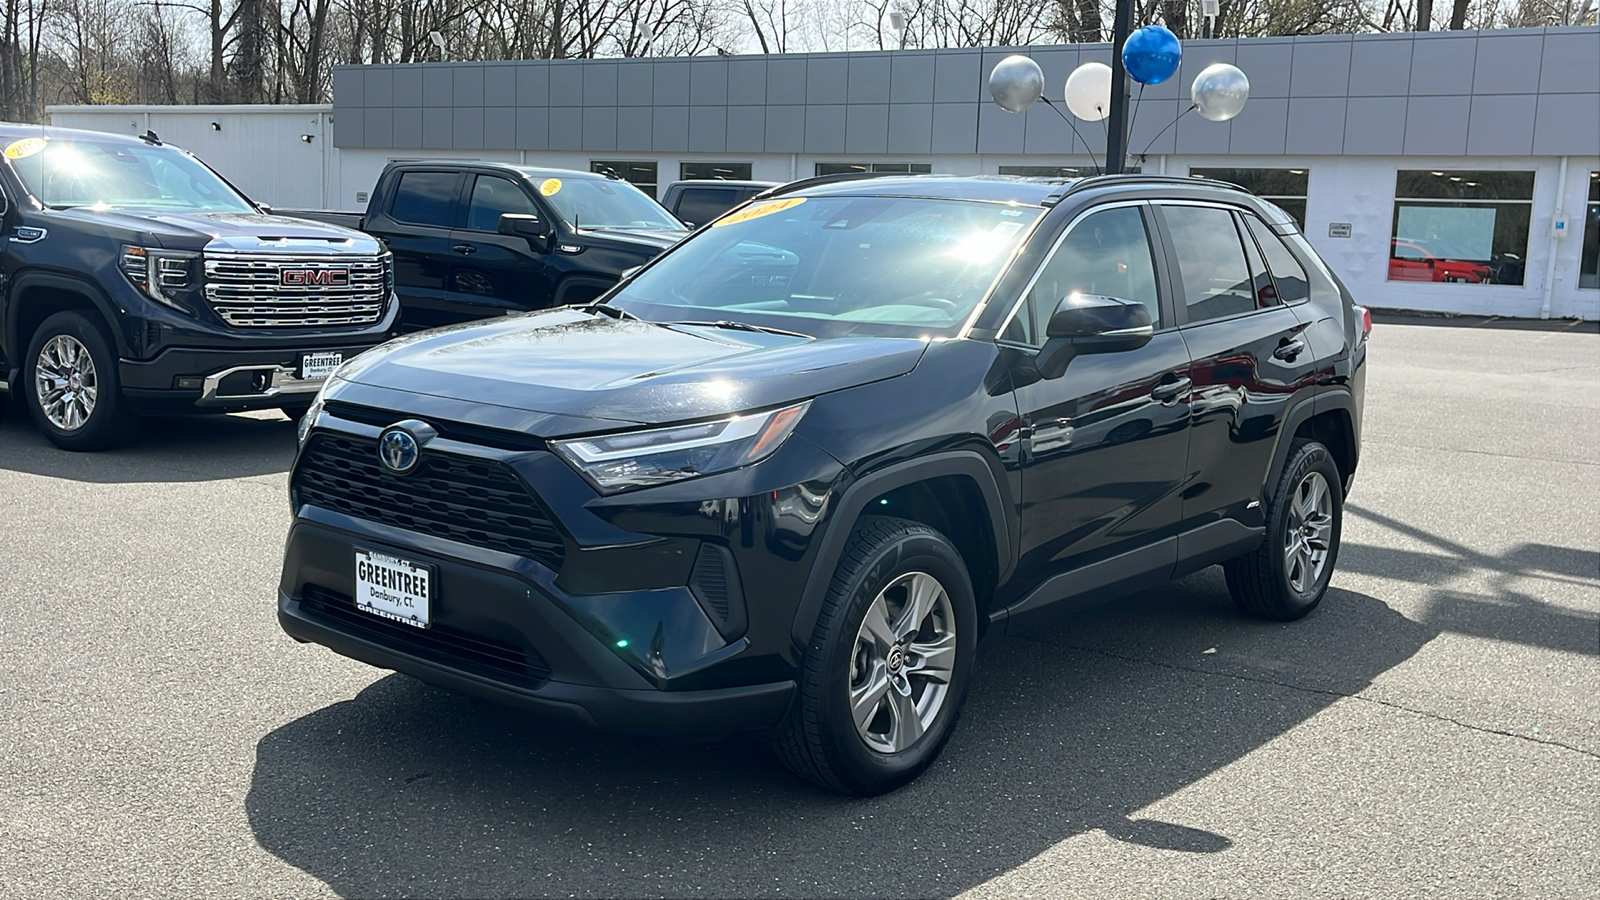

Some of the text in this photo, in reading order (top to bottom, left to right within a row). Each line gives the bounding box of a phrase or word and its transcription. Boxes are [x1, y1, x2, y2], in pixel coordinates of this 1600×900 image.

[283, 270, 347, 285] GMC
[305, 357, 340, 368] GREENTREE
[358, 560, 427, 599] GREENTREE
[370, 586, 415, 609] Danbury, CT.
[357, 604, 426, 629] GREENTREE
